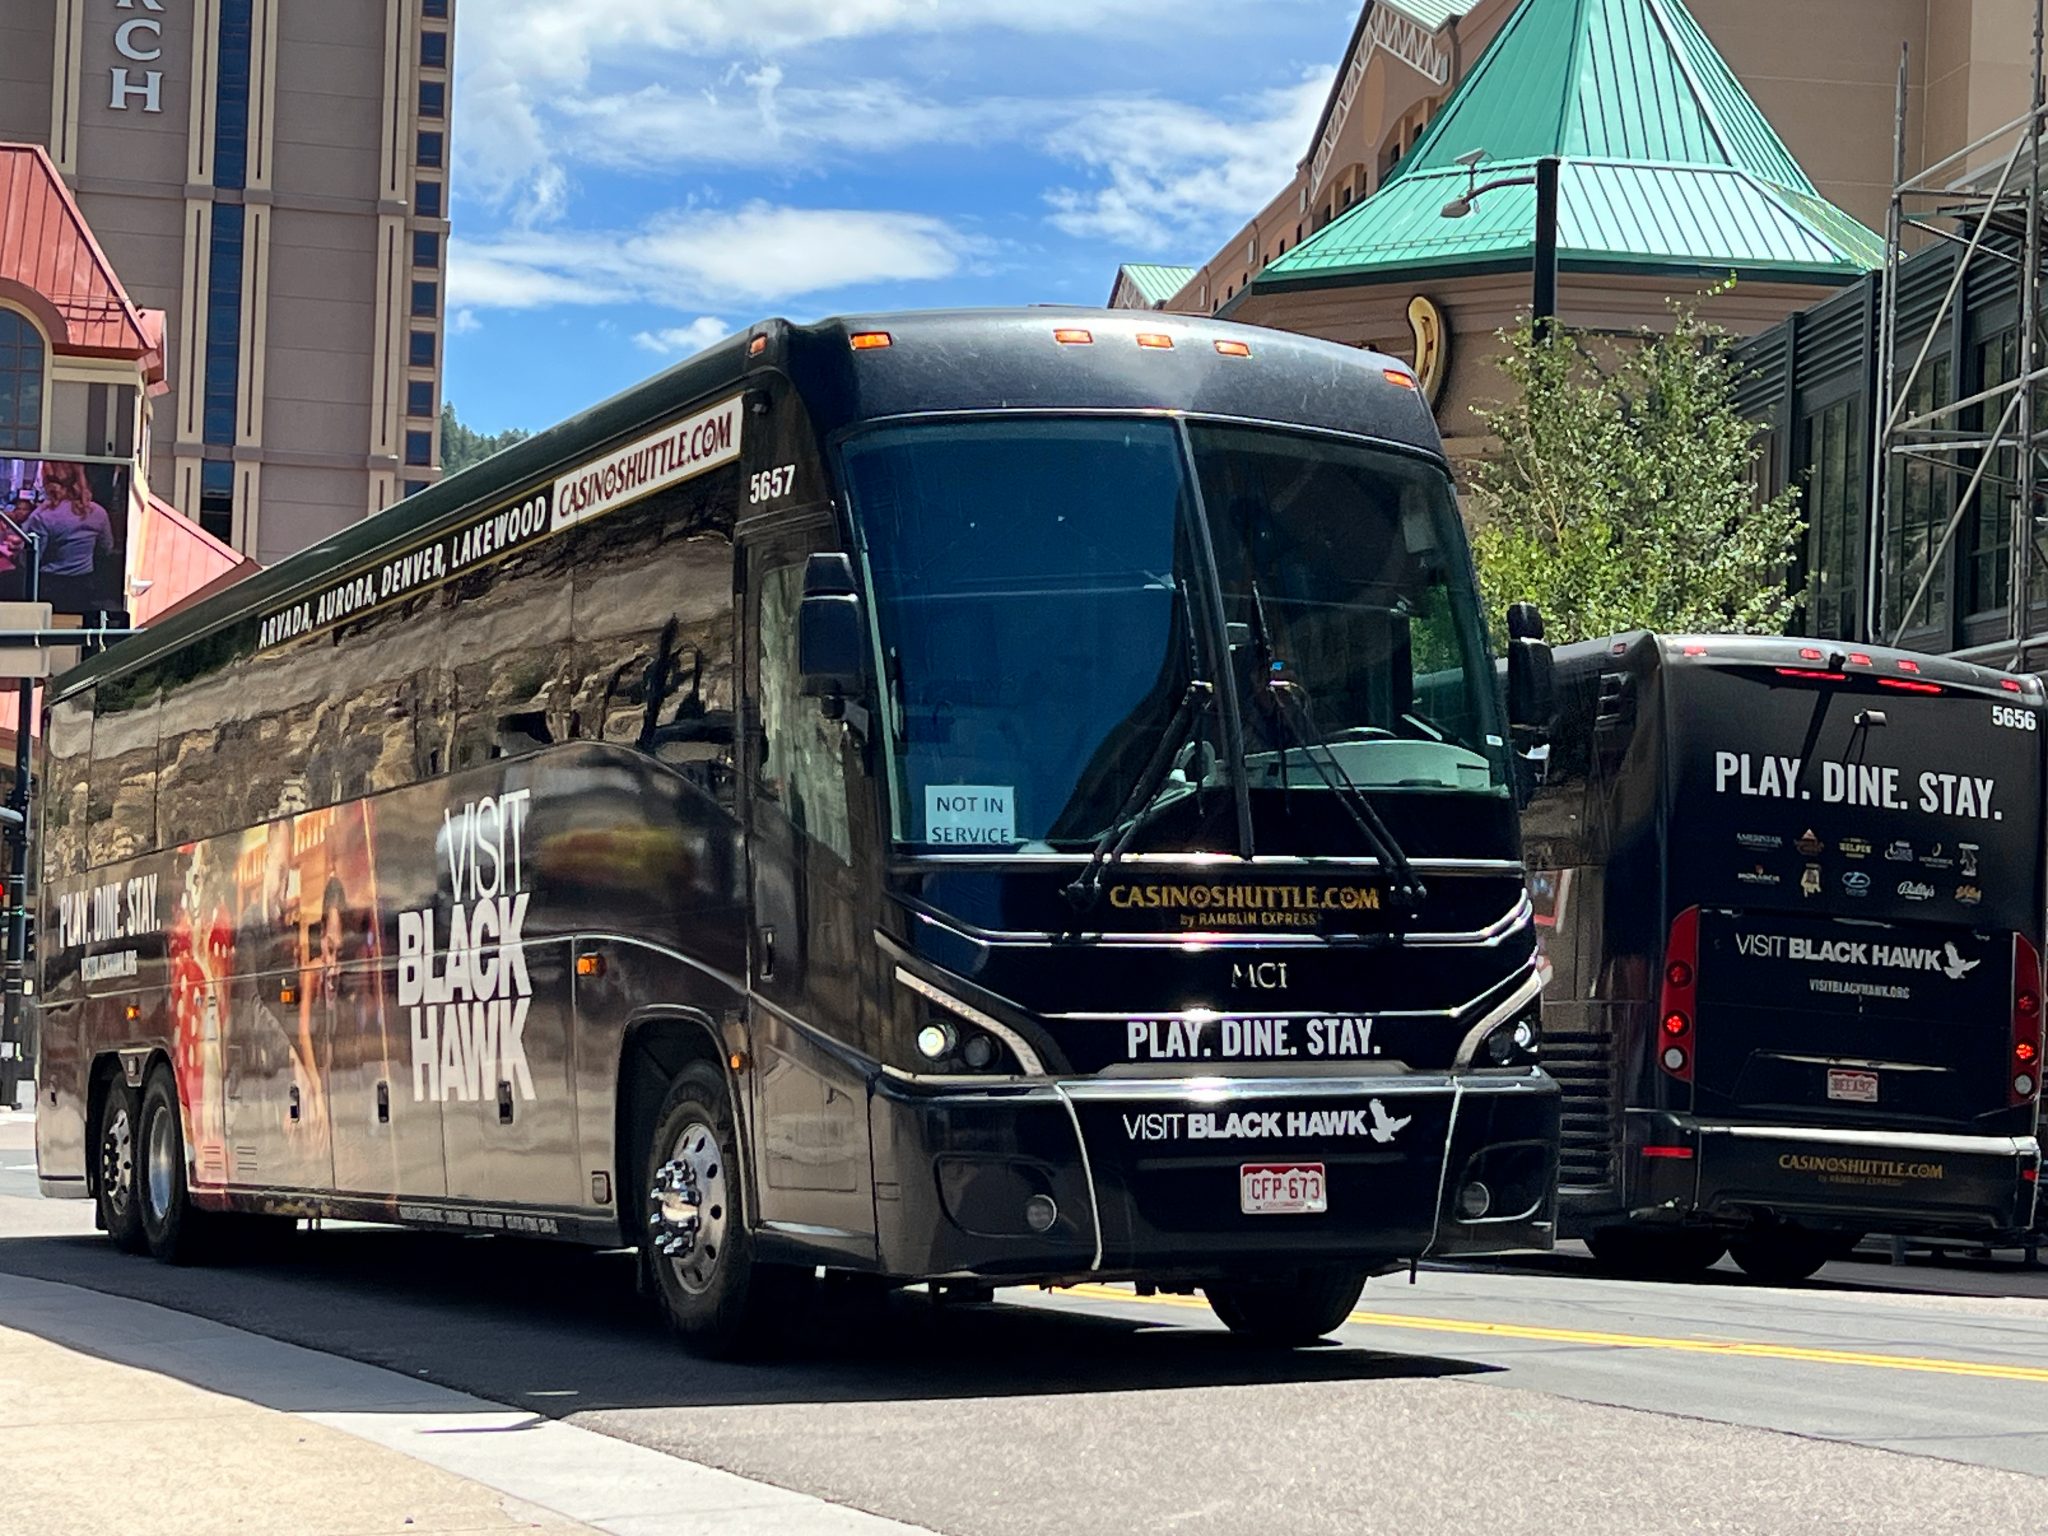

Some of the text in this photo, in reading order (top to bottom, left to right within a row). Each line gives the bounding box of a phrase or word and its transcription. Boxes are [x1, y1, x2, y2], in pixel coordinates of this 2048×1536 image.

[108, 0, 165, 112] CH
[560, 411, 733, 517] CASINOSHUTTLE.COM
[750, 464, 796, 504] 5657
[258, 496, 547, 650] ARVADA, AURORA, DENVER, LAKEWOOD
[1992, 706, 2037, 731] 5656
[936, 796, 1003, 813] NOT IN
[1715, 751, 2003, 821] PLAY. DINE. STAY.
[444, 788, 530, 902] VISIT
[931, 826, 1010, 844] SERVICE
[127, 873, 161, 936] STAY.
[1110, 885, 1380, 909] CASINOSHUTTLE.COM
[1180, 911, 1317, 927] by RAMBLIN EXPRESS
[398, 892, 533, 1006] BLACK
[1735, 933, 1942, 971] VISIT BLACK HAWK
[1231, 962, 1287, 988] MCI
[410, 997, 537, 1102] HAWK
[1127, 1018, 1381, 1058] PLAY. DINE. STAY.
[1123, 1110, 1368, 1140] VISIT BLACK HAWK
[1778, 1154, 1943, 1179] CASINOSHUTTLE.COM
